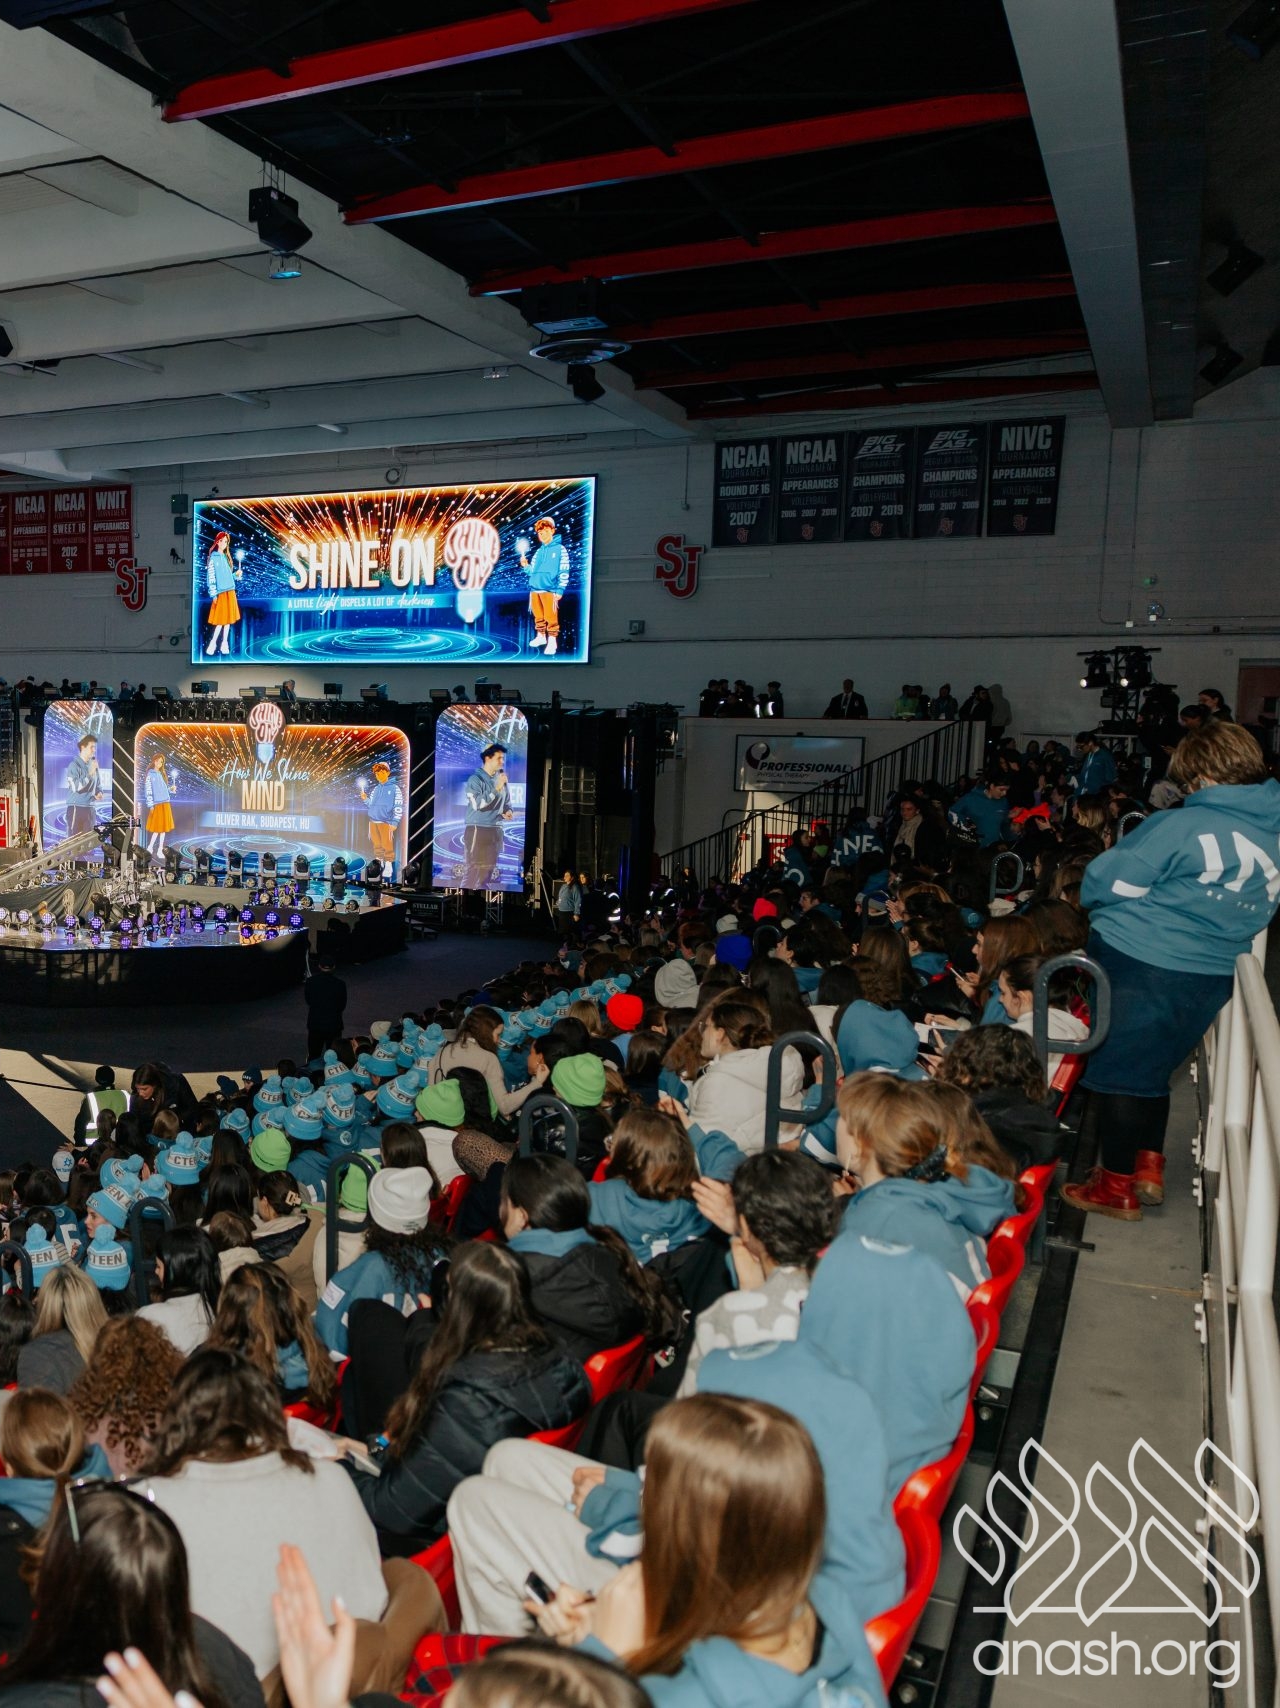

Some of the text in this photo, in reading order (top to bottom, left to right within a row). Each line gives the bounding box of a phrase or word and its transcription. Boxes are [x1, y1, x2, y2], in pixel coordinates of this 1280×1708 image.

[864, 435, 898, 445] BIG
[934, 430, 970, 440] BIG
[1000, 425, 1052, 452] NIVC
[858, 443, 906, 454] EAST
[928, 438, 978, 450] EAST
[722, 444, 770, 469] NCAA
[786, 440, 837, 464] NCAA
[923, 468, 978, 482] CHAMPIONS
[992, 466, 1056, 480] APPEARANCES
[782, 478, 838, 492] APPEARANCES
[853, 474, 905, 487] CHAMPIONS
[720, 483, 770, 496] ROUND OF 16
[15, 496, 45, 514] NCAA
[54, 492, 86, 512] NCAA
[96, 490, 127, 510] WNIT
[851, 504, 904, 518] 2007 2019
[730, 511, 758, 526] 2007
[52, 522, 86, 534] SWEET 16
[62, 546, 78, 557] 2012
[288, 537, 435, 590] SHINE ON
[559, 572, 569, 587] ON
[288, 600, 292, 608] A
[294, 599, 314, 608] LITTLE
[340, 598, 366, 607] DISPELS
[366, 598, 372, 606] A
[372, 597, 384, 606] LOT
[386, 597, 394, 606] OF
[250, 702, 282, 729] SHINE
[218, 756, 250, 786] How
[254, 758, 272, 782] We
[760, 762, 850, 774] PROFESSIONAL
[242, 780, 285, 811] MIND
[216, 814, 310, 830] OLIVER RAK, BUDAPEST, HU
